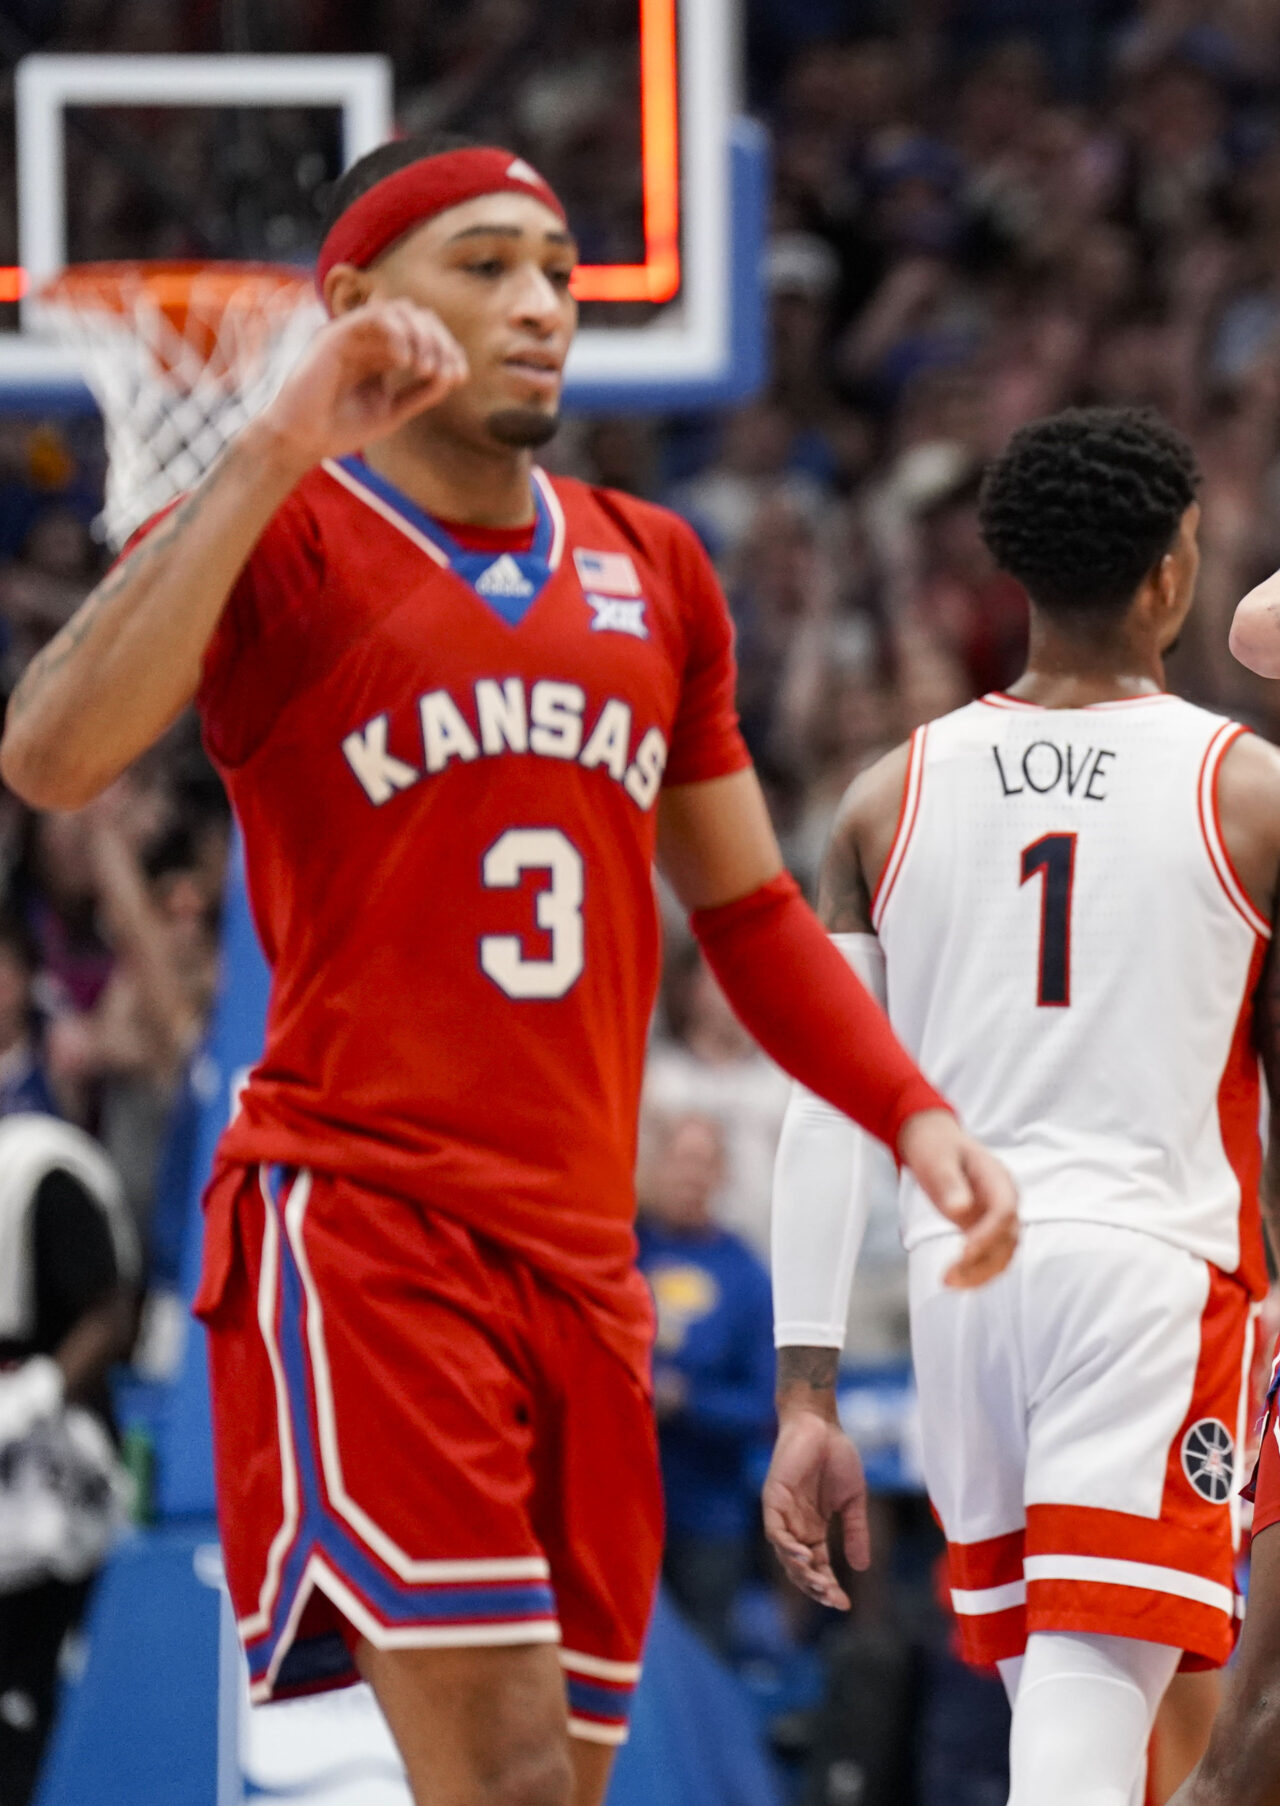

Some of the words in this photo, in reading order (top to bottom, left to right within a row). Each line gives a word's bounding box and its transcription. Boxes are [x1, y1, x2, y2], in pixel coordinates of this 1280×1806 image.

[341, 676, 668, 812] KANSAS
[991, 740, 1117, 802] LOVE
[480, 825, 585, 1001] 3
[1018, 831, 1078, 1007] 1
